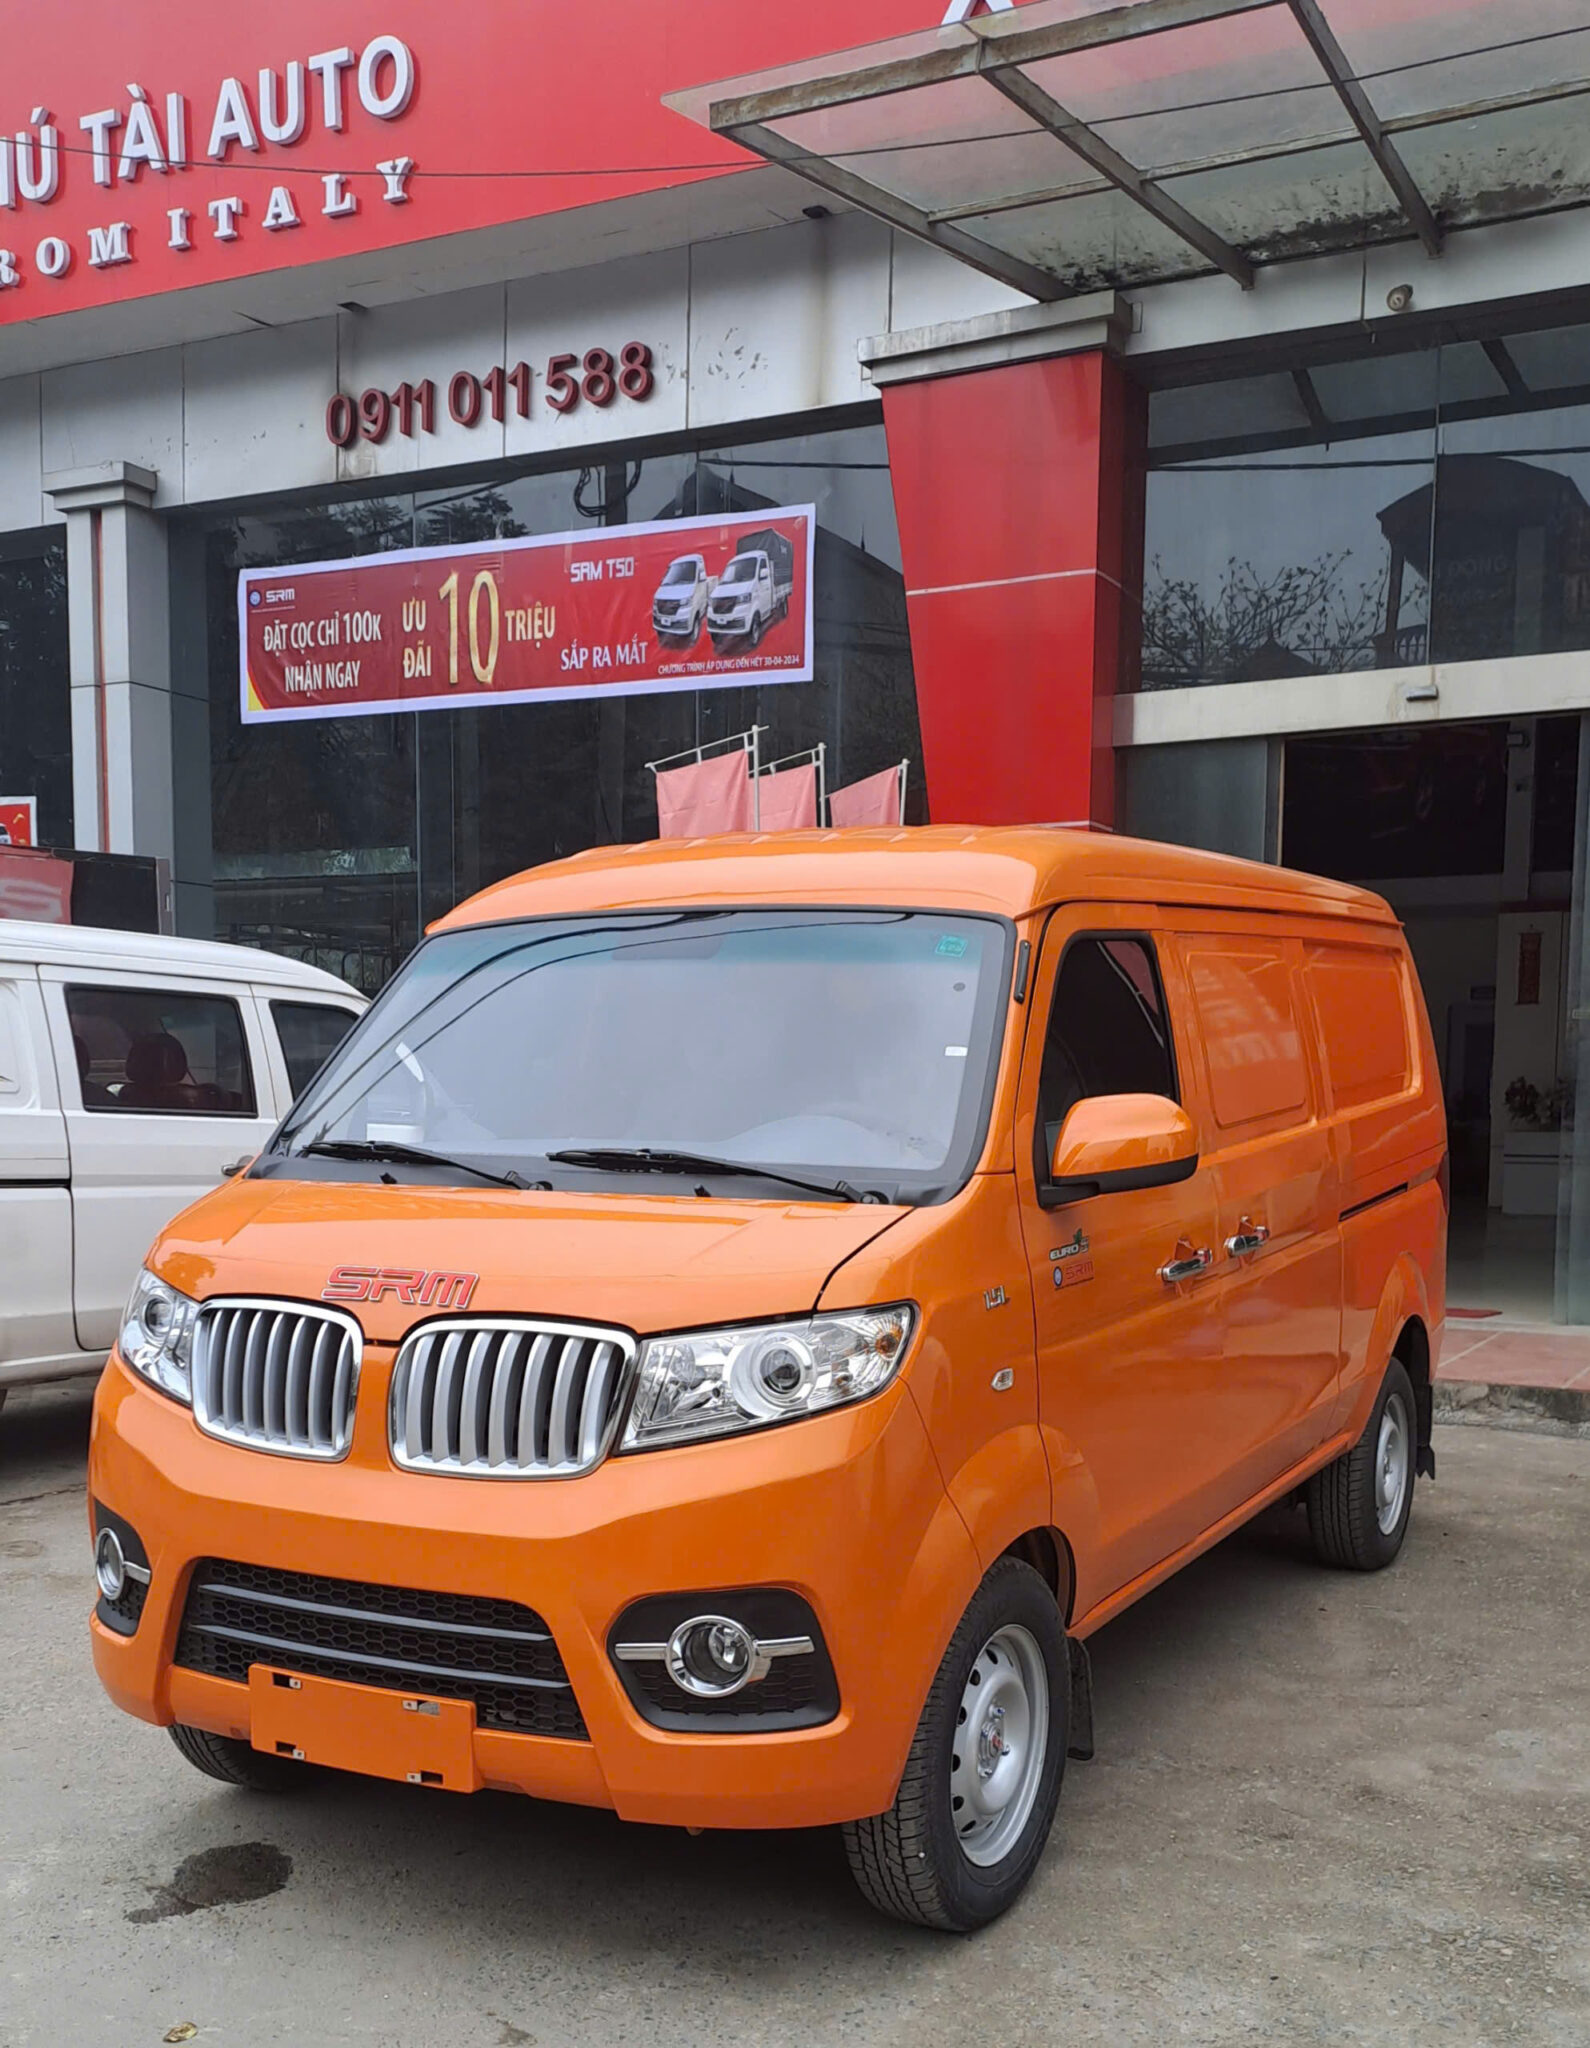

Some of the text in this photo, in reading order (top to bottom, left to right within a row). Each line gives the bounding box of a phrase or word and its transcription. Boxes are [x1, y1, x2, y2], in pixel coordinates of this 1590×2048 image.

[80, 82, 188, 187] TÀI
[207, 34, 416, 160] AUTO
[166, 156, 413, 251] ITALY
[326, 341, 653, 446] 0911 011 588
[266, 588, 295, 603] SRM
[263, 619, 288, 657] ĐẶT
[290, 620, 315, 655] CỌC
[317, 610, 340, 646] CHỈ
[438, 570, 500, 684] 10
[504, 601, 556, 649] TRIỆU
[402, 639, 432, 679] ĐÃI
[561, 632, 649, 671] SẮP RA MẮT
[284, 659, 361, 697] NHẬN NGAY
[1049, 1241, 1080, 1261] EURO
[321, 1264, 480, 1310] SRM
